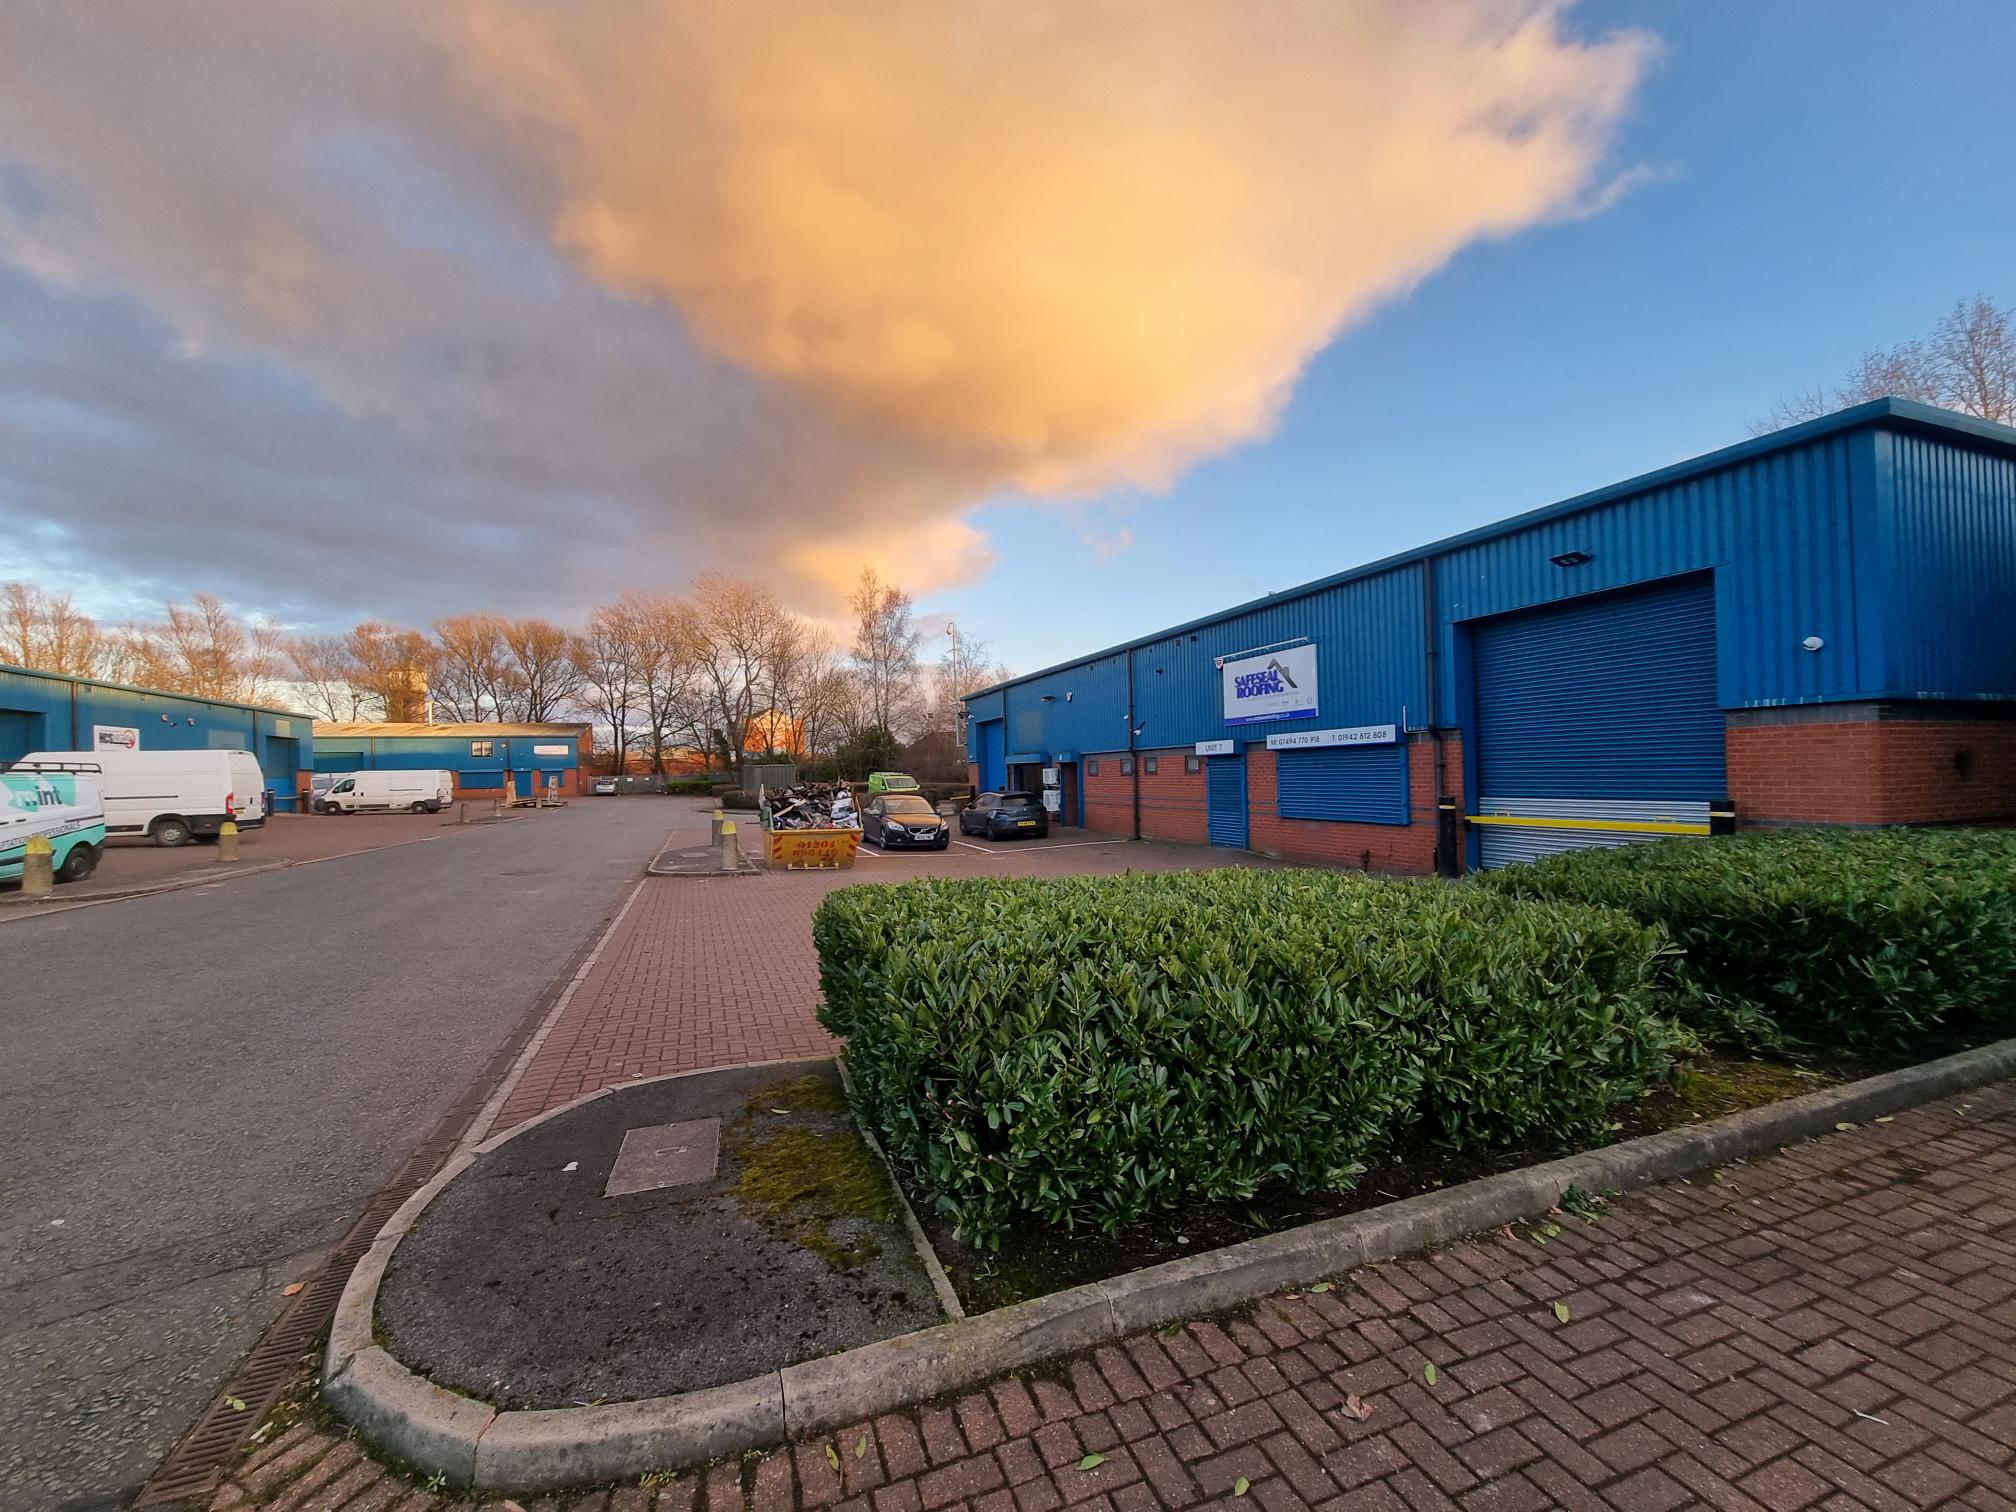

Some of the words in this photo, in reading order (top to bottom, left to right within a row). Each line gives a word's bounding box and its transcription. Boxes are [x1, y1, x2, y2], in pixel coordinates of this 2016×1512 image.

[1234, 669, 1279, 688] SAFESEAL
[1236, 680, 1284, 699] ROOFING
[1278, 737, 1297, 746] 07494
[1337, 733, 1358, 742] 01942
[1359, 732, 1371, 741] 812
[1373, 730, 1387, 740] 808
[1205, 744, 1217, 752] UNIT
